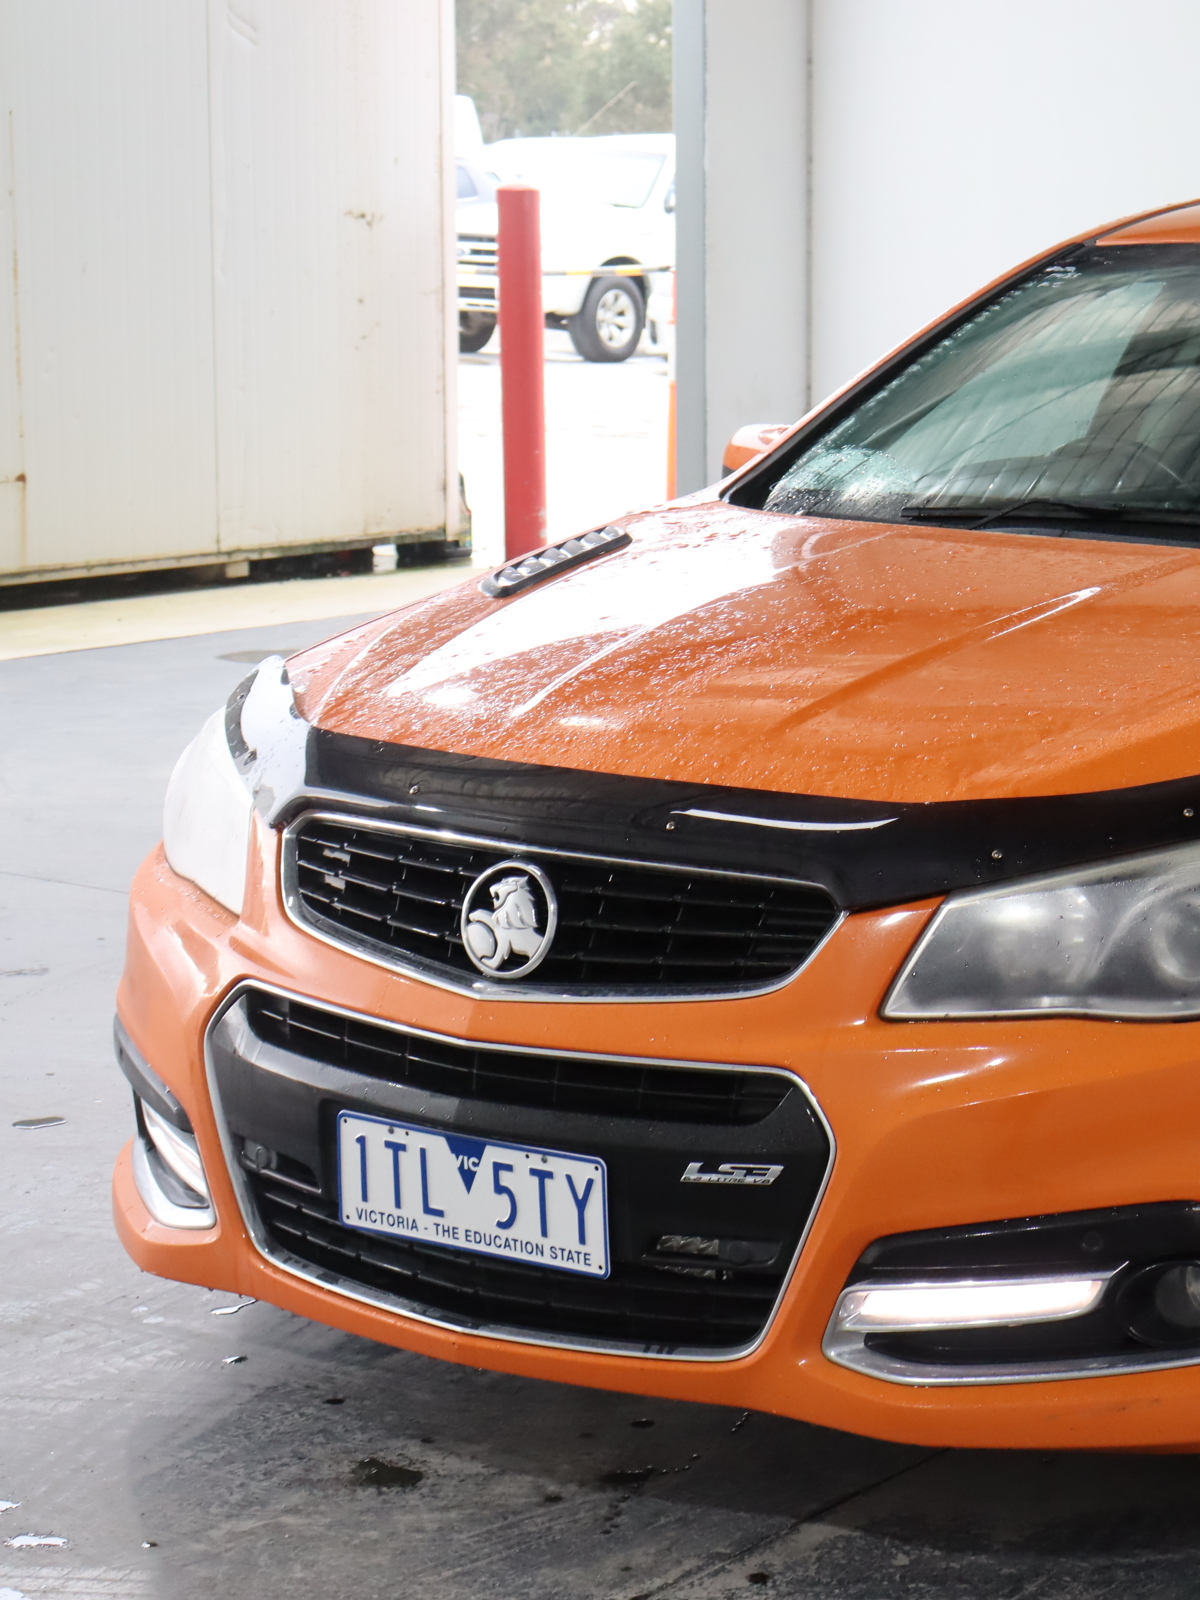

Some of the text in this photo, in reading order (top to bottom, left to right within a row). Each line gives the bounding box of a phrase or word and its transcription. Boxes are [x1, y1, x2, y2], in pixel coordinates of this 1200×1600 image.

[355, 1134, 595, 1246] 1TL 5TY
[451, 1152, 480, 1173] VIC
[355, 1207, 419, 1233] VICTORIA
[433, 1222, 460, 1240] THE
[464, 1230, 545, 1258] EDUCATION
[549, 1245, 592, 1267] STATE
